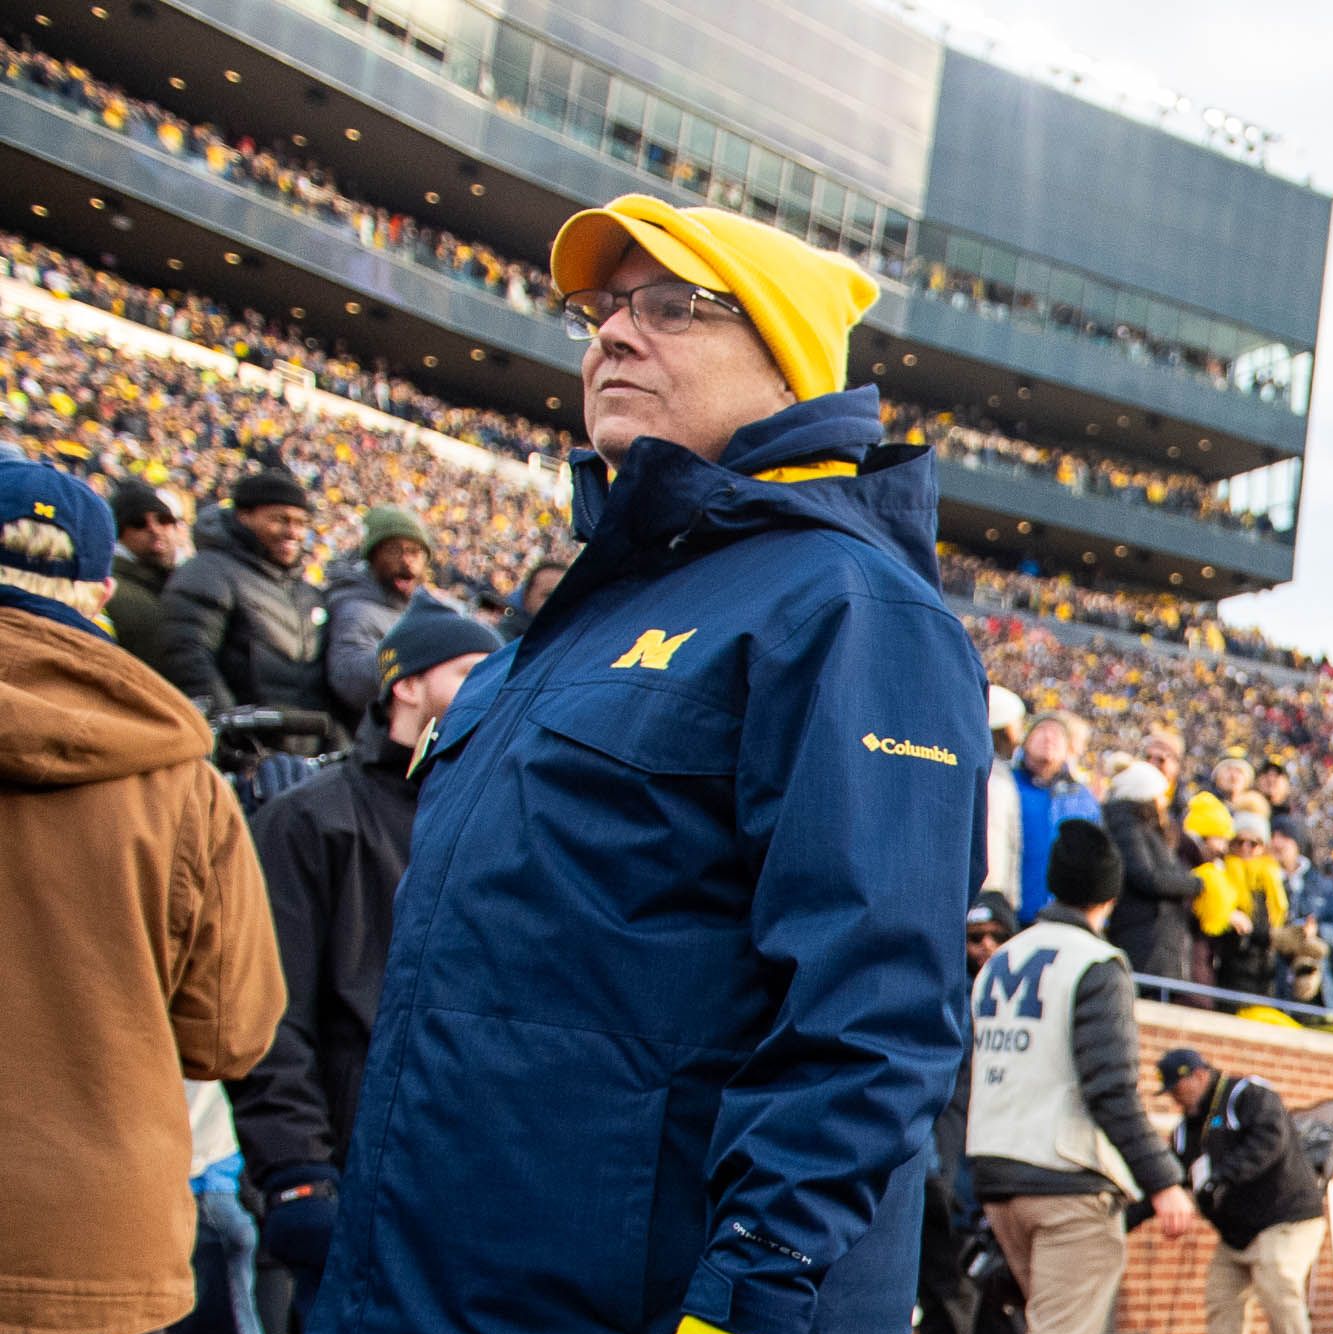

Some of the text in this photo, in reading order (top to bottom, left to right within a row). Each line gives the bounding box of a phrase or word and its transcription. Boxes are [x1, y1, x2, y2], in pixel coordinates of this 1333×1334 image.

[610, 627, 697, 670] M
[880, 738, 958, 766] Columbia
[975, 948, 1060, 1019] M
